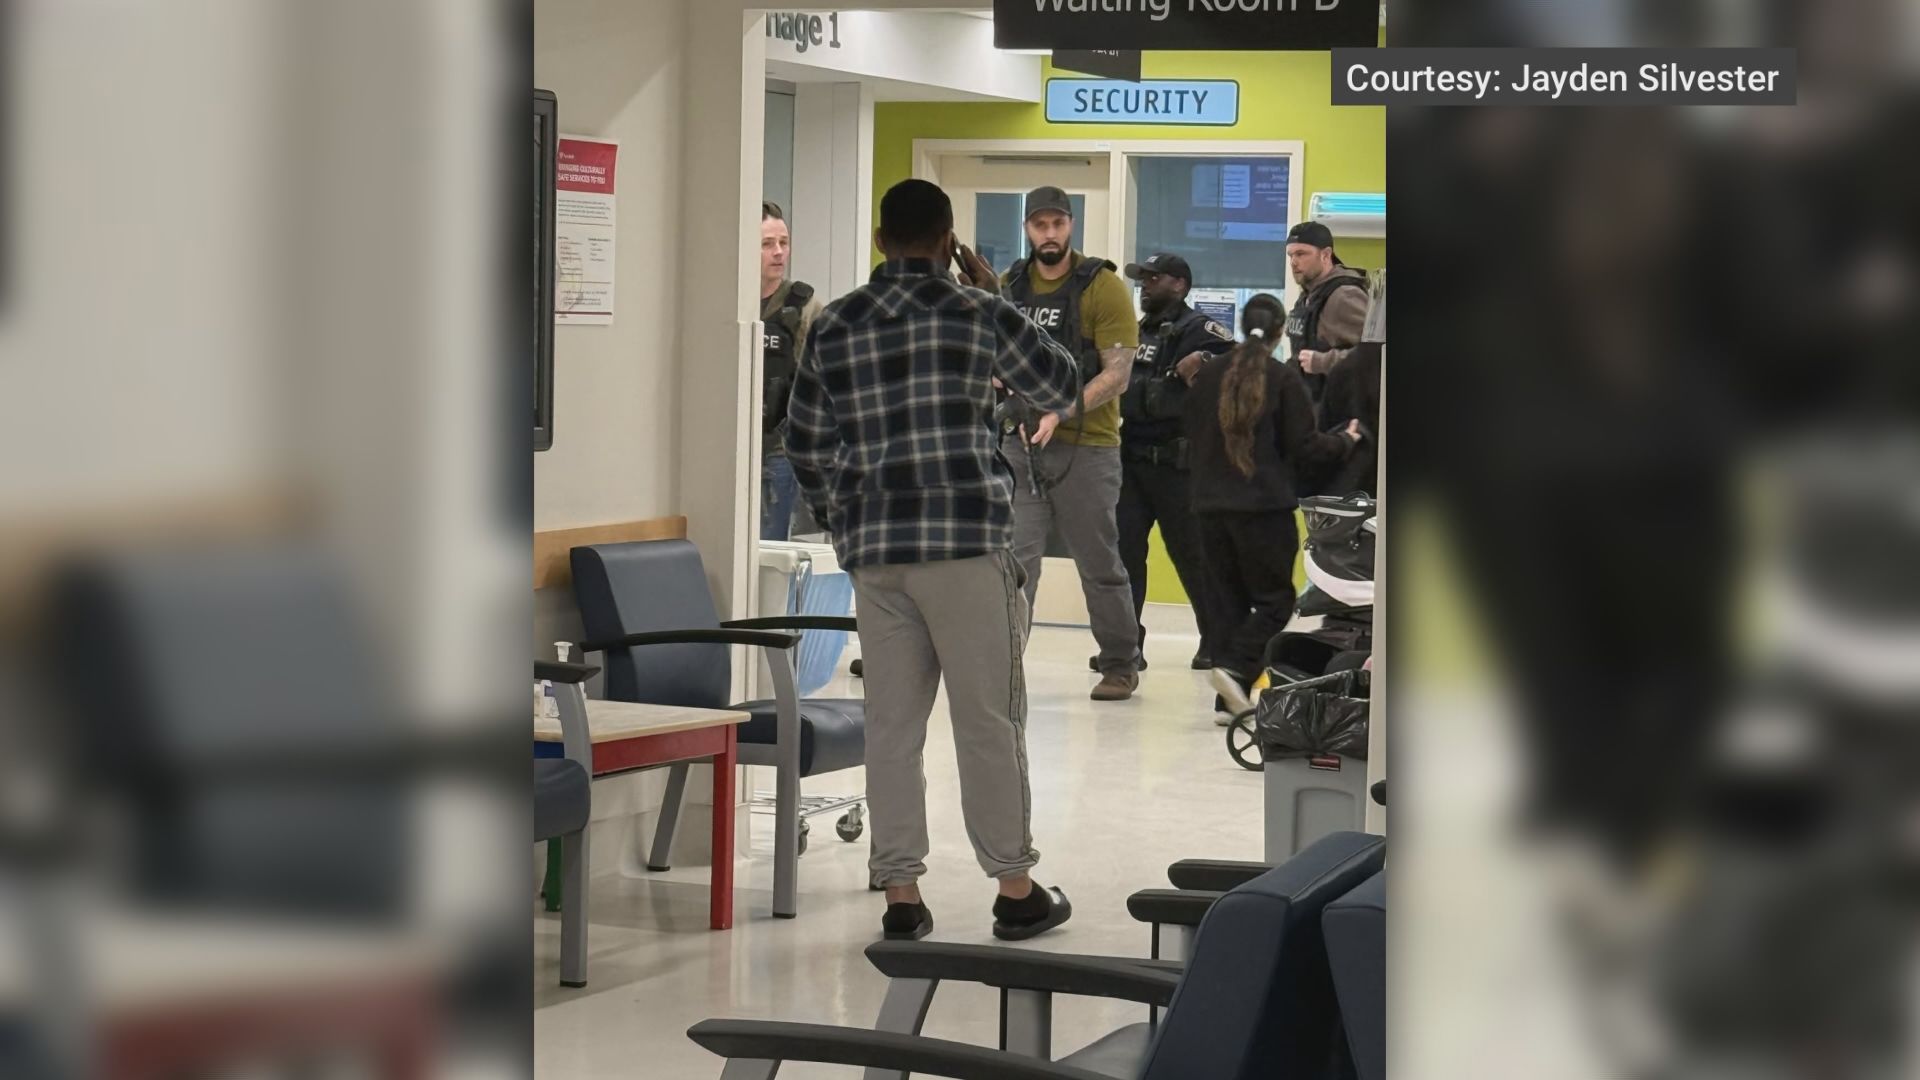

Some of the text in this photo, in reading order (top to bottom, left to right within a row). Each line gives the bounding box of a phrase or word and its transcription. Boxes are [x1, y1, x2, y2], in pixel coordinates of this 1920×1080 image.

[765, 11, 841, 53] riage 1
[1074, 88, 1209, 115] SECURITY
[763, 334, 780, 349] CE
[1136, 343, 1157, 362] CE
